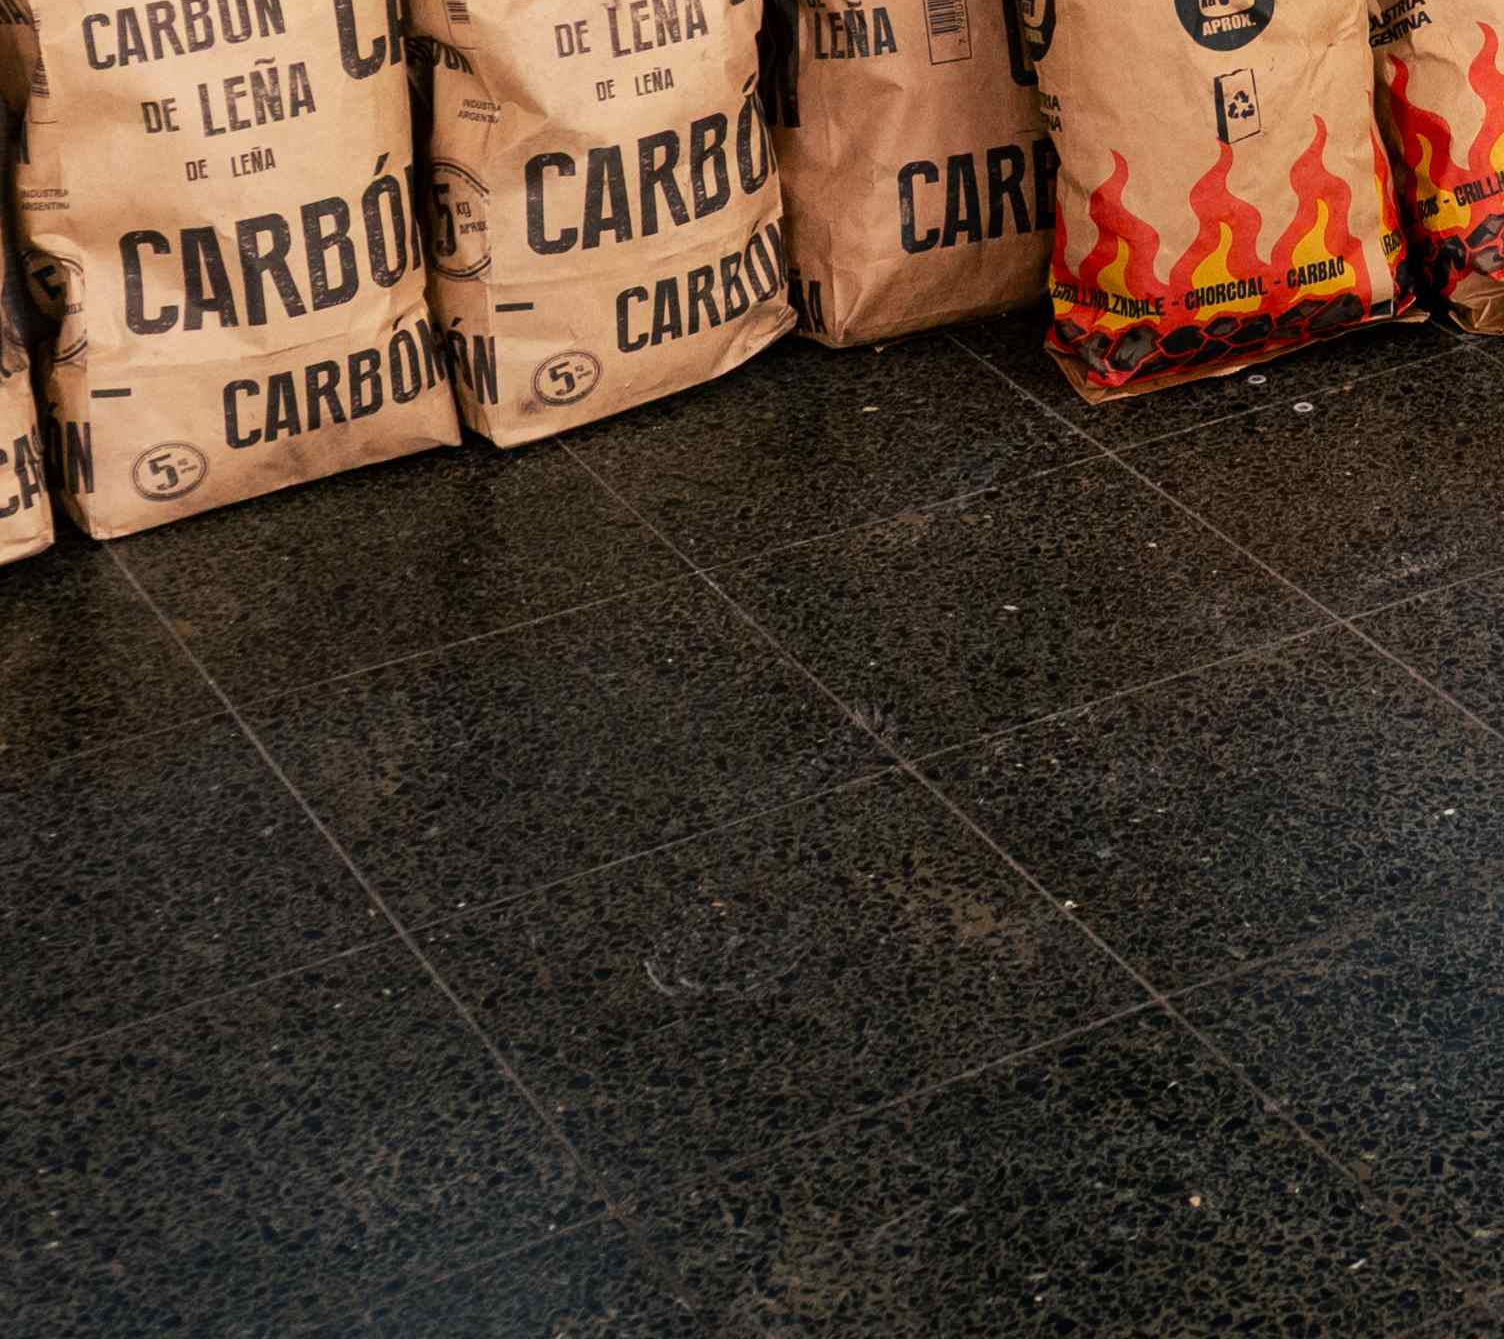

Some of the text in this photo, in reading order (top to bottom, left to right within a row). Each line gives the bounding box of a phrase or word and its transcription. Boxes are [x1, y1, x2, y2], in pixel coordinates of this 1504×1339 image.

[554, 19, 592, 59] DE
[814, 1, 899, 61] LEÑA
[1202, 13, 1258, 37] APROX.
[141, 57, 317, 137] DE LEÑA
[596, 67, 675, 102] DE LEÑA
[186, 147, 277, 182] DE LEÑA
[1184, 276, 1268, 312] CHORCOAL
